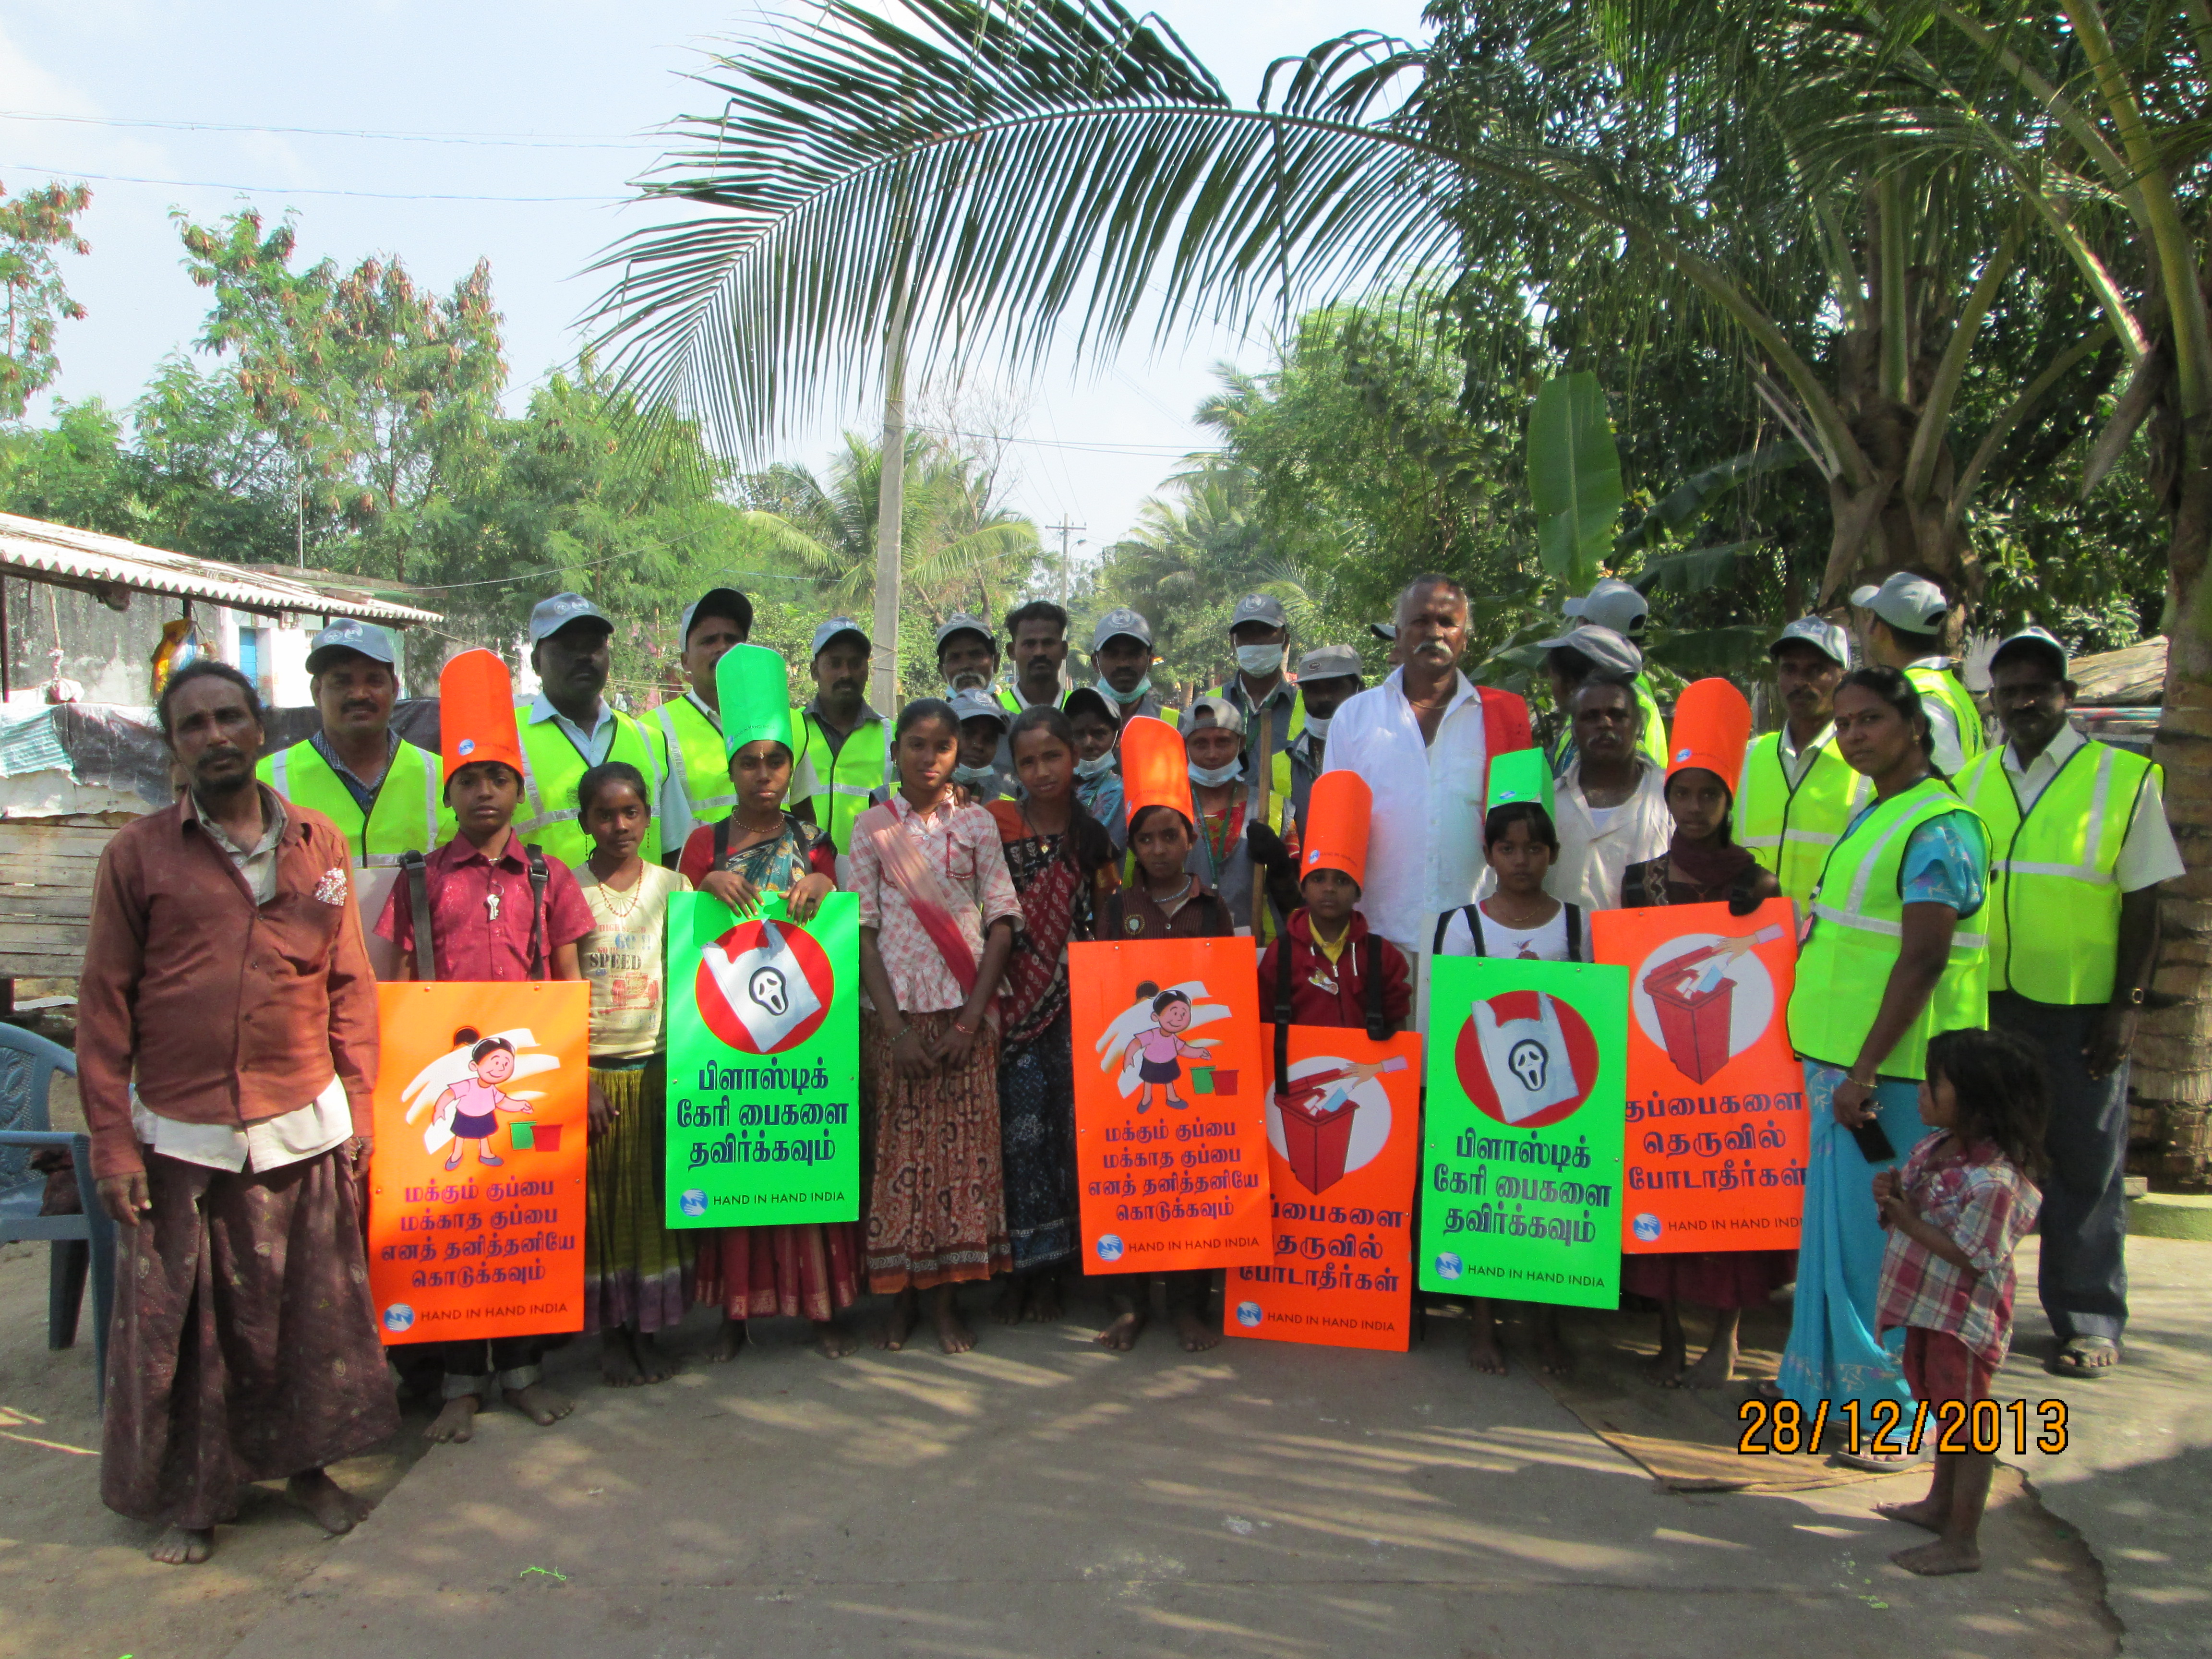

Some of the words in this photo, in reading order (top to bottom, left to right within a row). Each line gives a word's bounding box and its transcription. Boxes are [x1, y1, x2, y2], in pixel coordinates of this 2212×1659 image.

[589, 953, 642, 970] SPEED
[699, 1056, 829, 1095] பிளாஸ்டிக்
[677, 1094, 730, 1128] கேரி
[739, 1103, 849, 1126] பைகளை
[1106, 1119, 1169, 1143] மக்கும்
[1175, 1117, 1236, 1141] குப்பை
[1643, 1119, 1786, 1158] தெருவில்
[688, 1128, 835, 1172] தவிர்க்கவும்
[1103, 1146, 1174, 1170] மக்காத
[1181, 1143, 1241, 1167] குப்பை
[1457, 1127, 1591, 1173] பிளாஸ்டிக்
[405, 1178, 478, 1203] மக்கும்
[486, 1175, 553, 1201] குப்பை
[1088, 1172, 1136, 1197] எனத்
[1143, 1170, 1259, 1196] தனித்தனியே
[1433, 1163, 1486, 1195] கேரி
[1496, 1175, 1612, 1207] பைகளை
[1629, 1159, 1808, 1191] போடாதீர்கள்
[713, 1195, 750, 1206] HAND
[754, 1194, 767, 1204] IN
[771, 1193, 807, 1204] HAND
[811, 1191, 845, 1202] INDIA
[1117, 1196, 1234, 1222] கொடுக்கவும்
[400, 1208, 481, 1232] மக்காத
[490, 1204, 558, 1229] குப்பை
[1443, 1202, 1595, 1247] தவிர்க்கவும்
[1668, 1219, 1707, 1232] HAND
[1711, 1218, 1727, 1230] IN
[1731, 1217, 1771, 1229] HAND
[381, 1237, 437, 1262] எனத்
[444, 1232, 576, 1259] தனித்தனியே
[1129, 1242, 1165, 1253] HAND
[1169, 1241, 1182, 1251] IN
[1185, 1239, 1221, 1250] HAND
[1225, 1237, 1260, 1247] INDIA
[413, 1258, 545, 1288] கொடுக்கவும்
[1468, 1263, 1505, 1278] HAND
[1509, 1268, 1523, 1280] IN
[1527, 1270, 1564, 1284] HAND
[1568, 1274, 1605, 1288] INDIA
[421, 1310, 462, 1321] HAND
[466, 1308, 481, 1319] IN
[485, 1306, 526, 1317] HAND
[529, 1303, 568, 1315] INDIA
[1267, 1311, 1302, 1324] HAND
[1306, 1314, 1319, 1325] IN
[1322, 1316, 1358, 1328] HAND
[1361, 1320, 1395, 1332] INDIA
